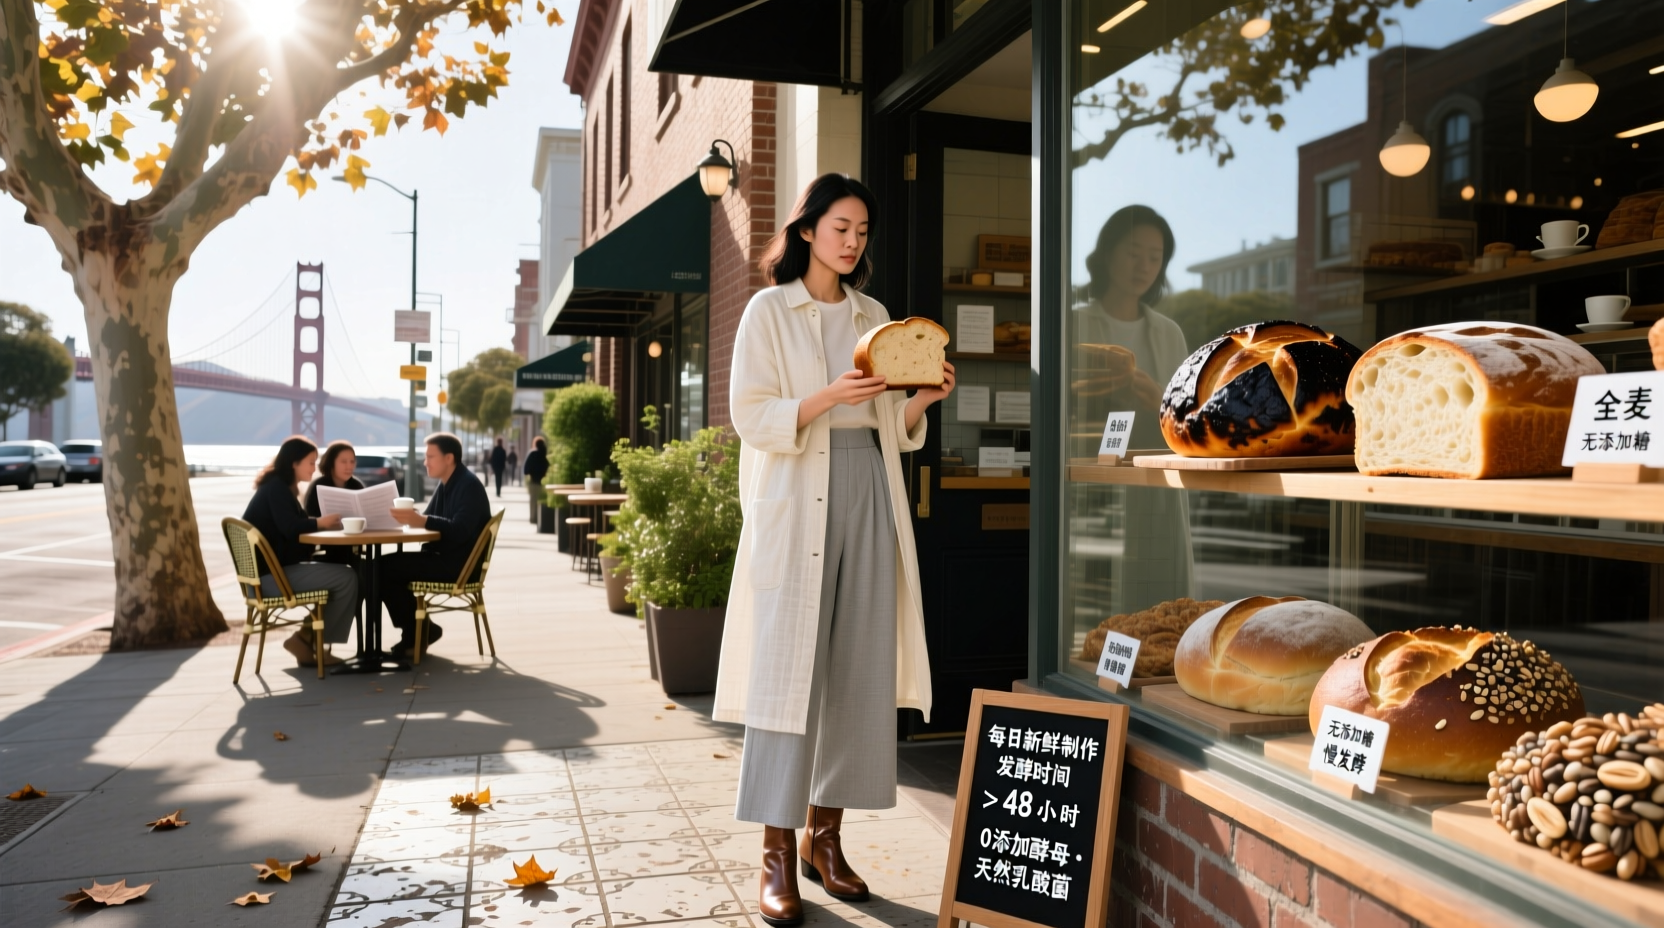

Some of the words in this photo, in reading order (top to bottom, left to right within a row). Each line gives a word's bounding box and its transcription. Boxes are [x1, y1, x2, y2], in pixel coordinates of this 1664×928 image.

[1593, 386, 1652, 421] 全麦
[988, 724, 1099, 762] 每日新鲜制作
[996, 755, 1071, 788] 发酵时间
[974, 856, 1072, 901] 天然乳酸菌
